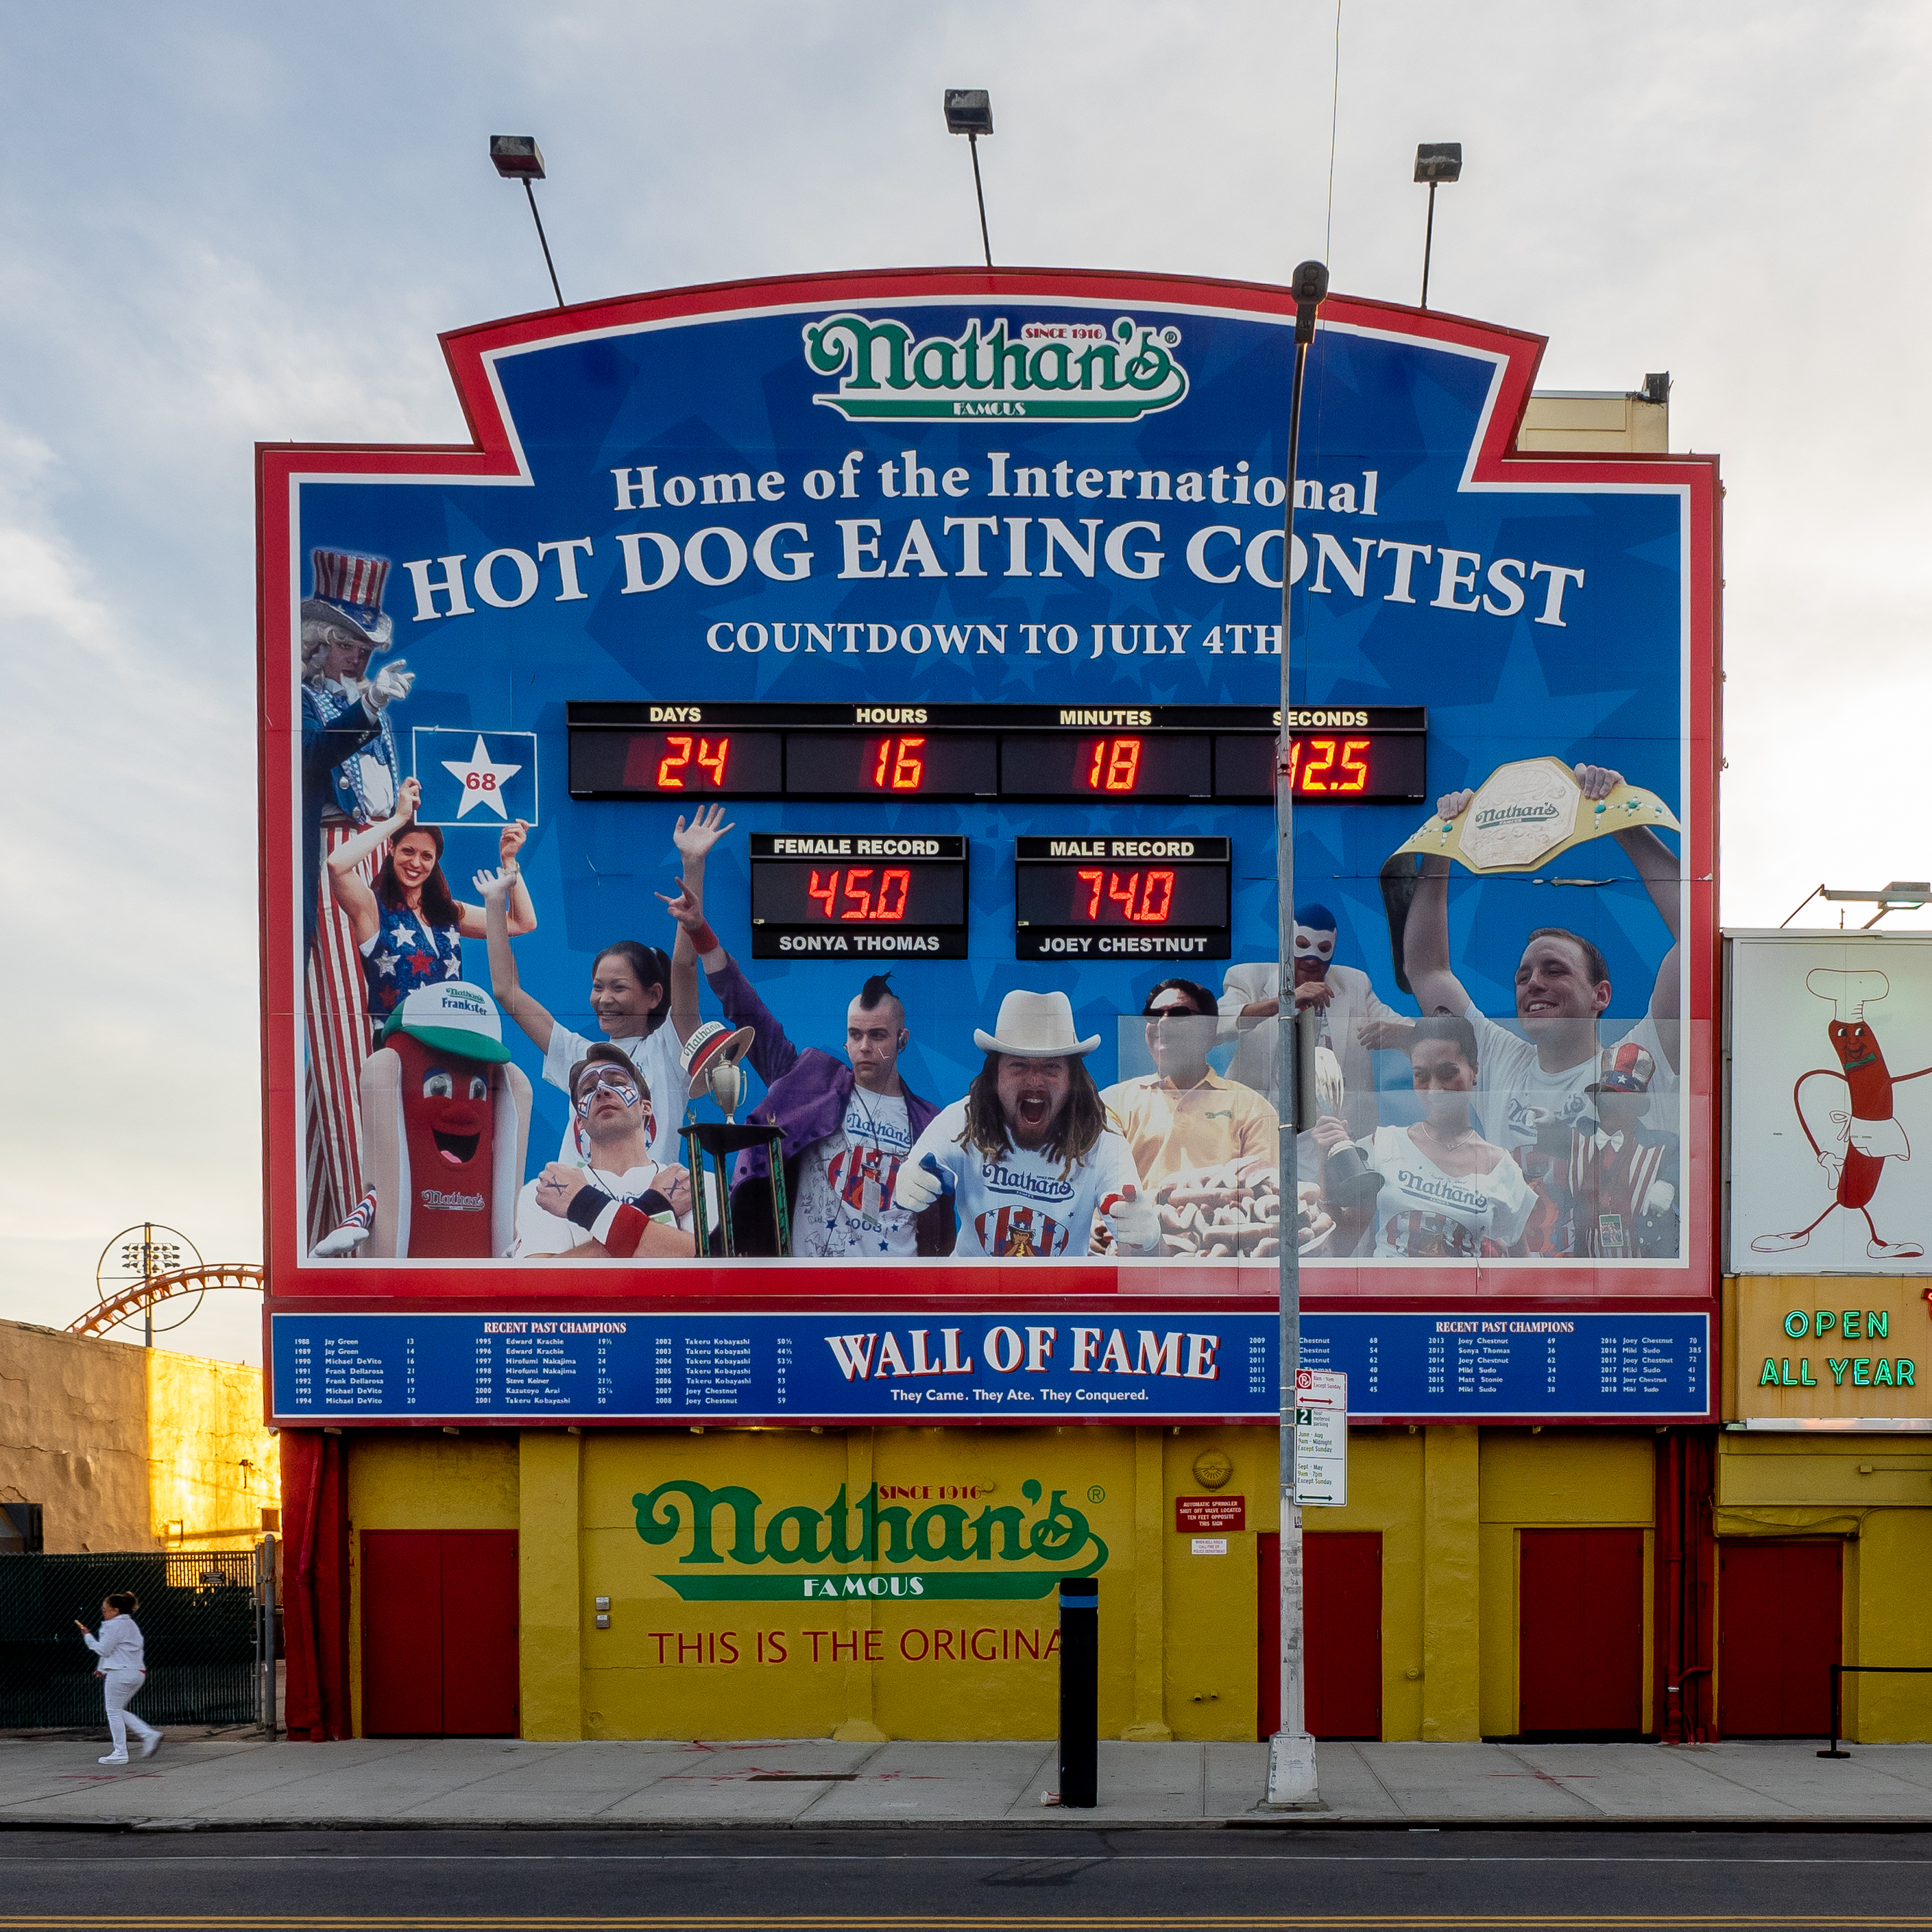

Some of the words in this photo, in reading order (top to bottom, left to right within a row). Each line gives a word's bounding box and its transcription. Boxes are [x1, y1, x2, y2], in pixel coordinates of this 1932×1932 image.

[1025, 326, 1068, 339] SINCE
[1071, 328, 1103, 340] 1916
[950, 400, 1028, 416] FAMOUS
[611, 466, 784, 510] Home
[804, 451, 863, 499] of
[878, 450, 969, 497] the
[987, 452, 1378, 516] International
[403, 537, 593, 620] HOT
[616, 522, 814, 594] DOG
[836, 516, 1164, 579] EATING
[1185, 524, 1586, 629] CONTEST
[708, 623, 1008, 653] COUNTDOWN
[1020, 624, 1077, 653] TO
[1091, 625, 1192, 658] JULY
[1203, 625, 1282, 653] 4TH
[651, 708, 701, 722] DAYS
[857, 709, 927, 723] HOURS
[1061, 711, 1151, 725] MINUTES
[1273, 711, 1368, 726] SECONDS
[657, 736, 729, 787] 24
[876, 738, 926, 788] 16
[1089, 740, 1141, 790] 18
[466, 772, 497, 791] 68
[1475, 801, 1558, 823] Nathan's
[775, 839, 851, 854] FEMALE
[858, 841, 939, 854] RECORD
[1051, 842, 1104, 856] MALE
[1113, 842, 1194, 856] RECORD
[808, 869, 911, 920] 45.0
[1077, 871, 1174, 921] 74.0
[780, 937, 847, 950] SONYA
[854, 937, 939, 950] THOMAS
[1039, 938, 1092, 952] JOEY
[1099, 938, 1207, 952] CHESTNUT
[442, 997, 488, 1016] Frankster
[485, 1323, 528, 1333] RECENT
[531, 1323, 557, 1333] PAST
[560, 1323, 626, 1333] CHAMPIONS
[1437, 1322, 1478, 1332] RECENT
[1482, 1322, 1507, 1332] PAST
[1510, 1322, 1573, 1332] CHAMPIONS
[1783, 1309, 1889, 1339] OPEN
[1298, 1336, 1331, 1344] Chestnut
[542, 1357, 577, 1366] Nakajima
[825, 1329, 975, 1382] WALL
[983, 1326, 1057, 1374] OF
[1070, 1327, 1220, 1381] FAME
[714, 1368, 751, 1376] Kobayashi
[1759, 1357, 1818, 1388] ALL
[1828, 1357, 1916, 1388] YEAR
[891, 1390, 921, 1403] They
[926, 1390, 968, 1400] Came.
[973, 1390, 1003, 1403] They
[1007, 1390, 1034, 1399] Ate.
[1041, 1390, 1071, 1403] They
[1076, 1390, 1148, 1403] Conquered.
[1300, 1409, 1307, 1423] 2
[879, 1484, 933, 1501] SINCE
[938, 1484, 982, 1501] 1916
[631, 1479, 1091, 1565] Nathan's
[803, 1576, 925, 1597] FAMOUS
[648, 1632, 740, 1664] THIS
[756, 1631, 788, 1663] IS
[802, 1630, 884, 1663] THE
[899, 1628, 1060, 1662] ORIGINA
